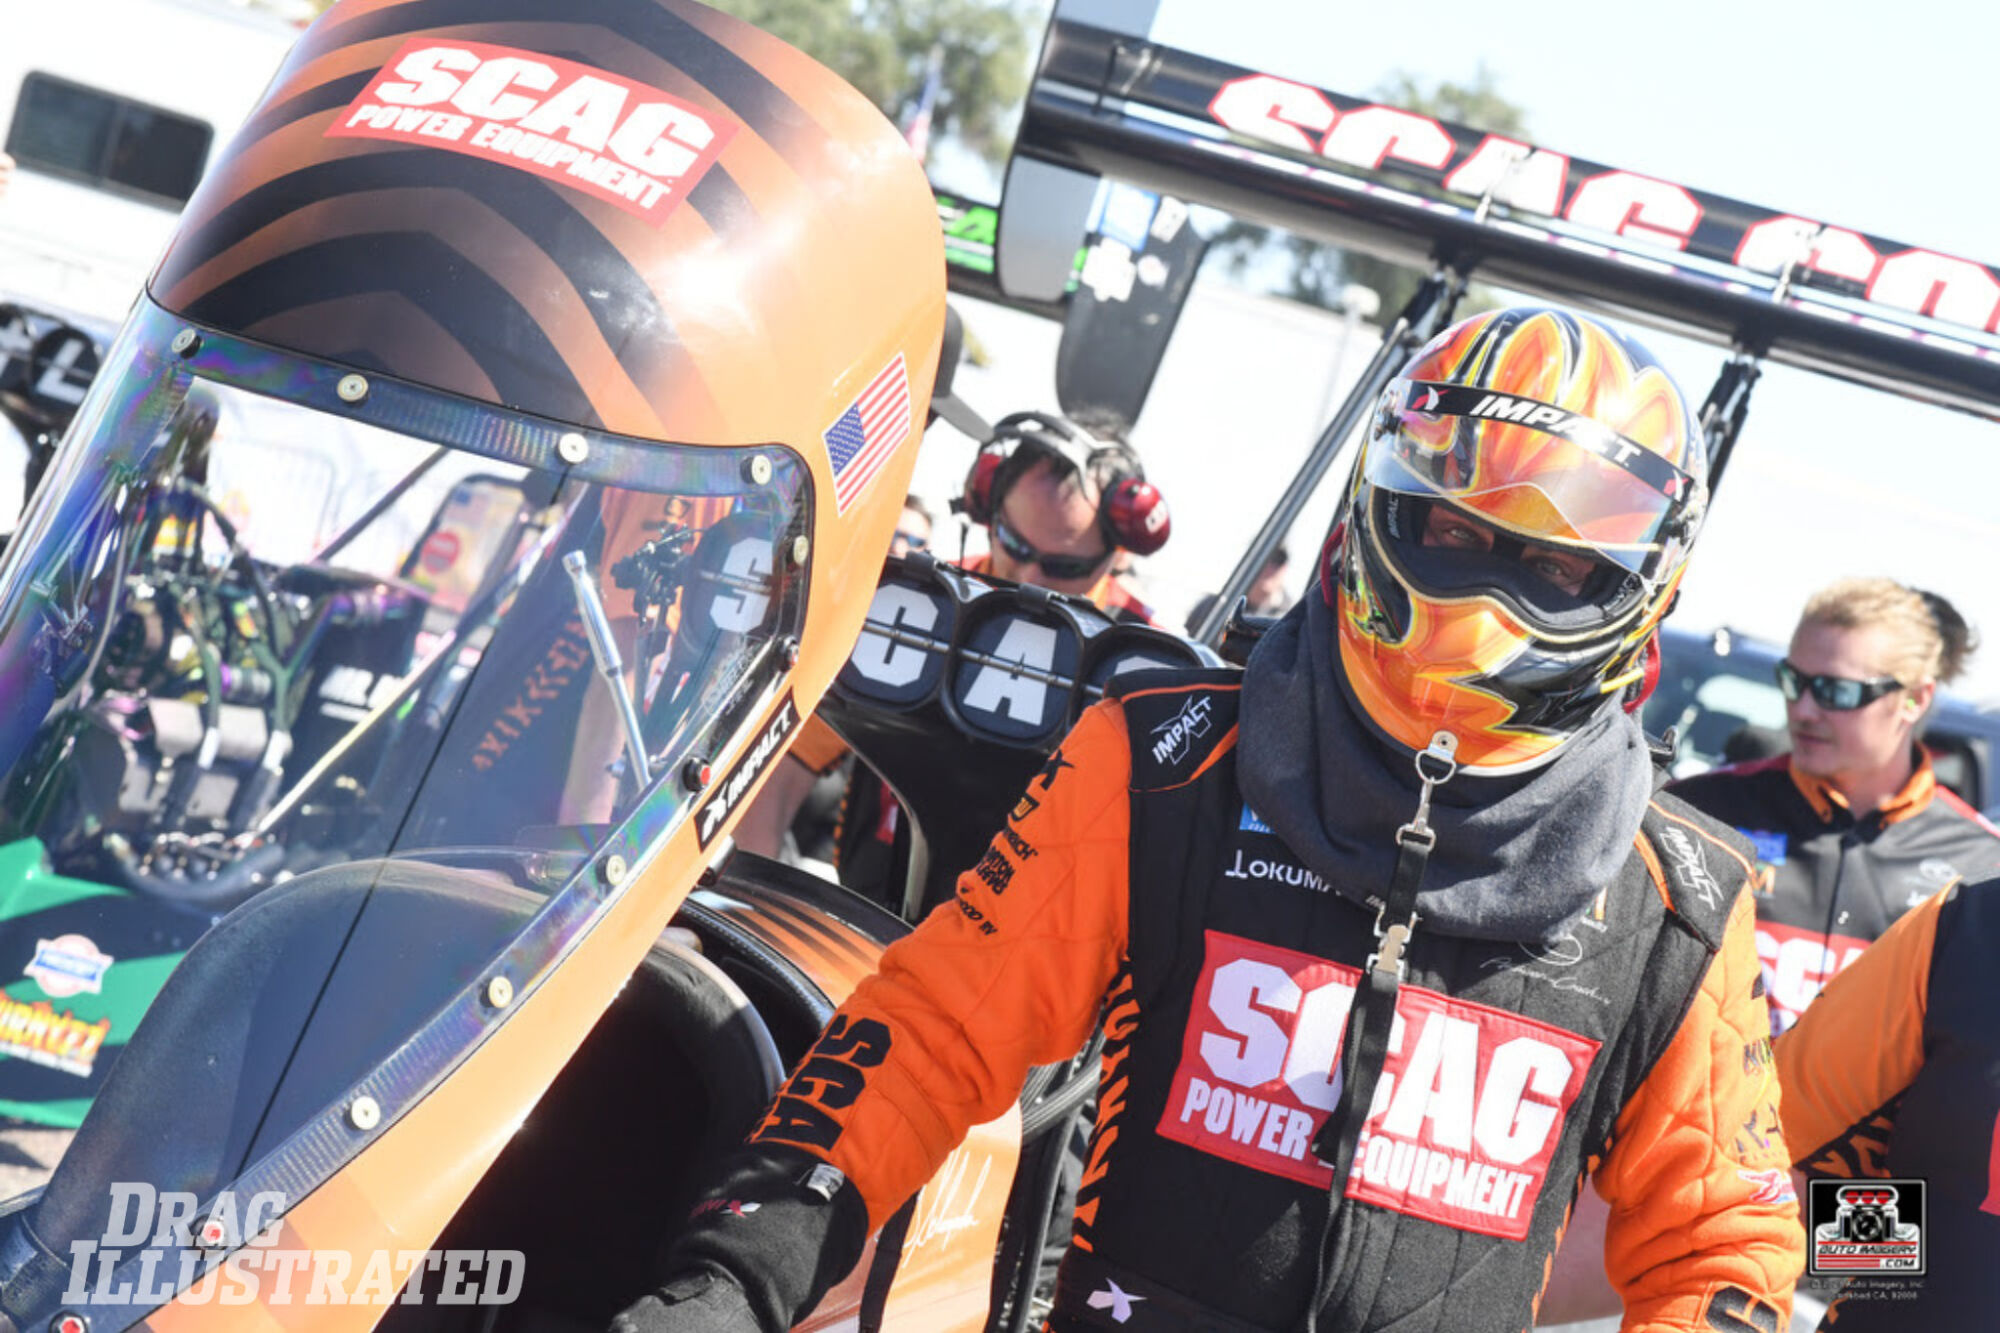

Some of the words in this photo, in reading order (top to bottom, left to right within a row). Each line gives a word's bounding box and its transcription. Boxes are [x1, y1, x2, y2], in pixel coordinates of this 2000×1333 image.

[346, 104, 474, 142] POWER
[470, 122, 672, 210] EQUIPMENT
[374, 46, 715, 178] SCAG
[726, 700, 793, 809] IMPACT
[1152, 695, 1212, 764] IMPACT
[754, 1013, 892, 1152] SCA
[1199, 957, 1574, 1166] SCAG
[1180, 1076, 1314, 1161] POWER
